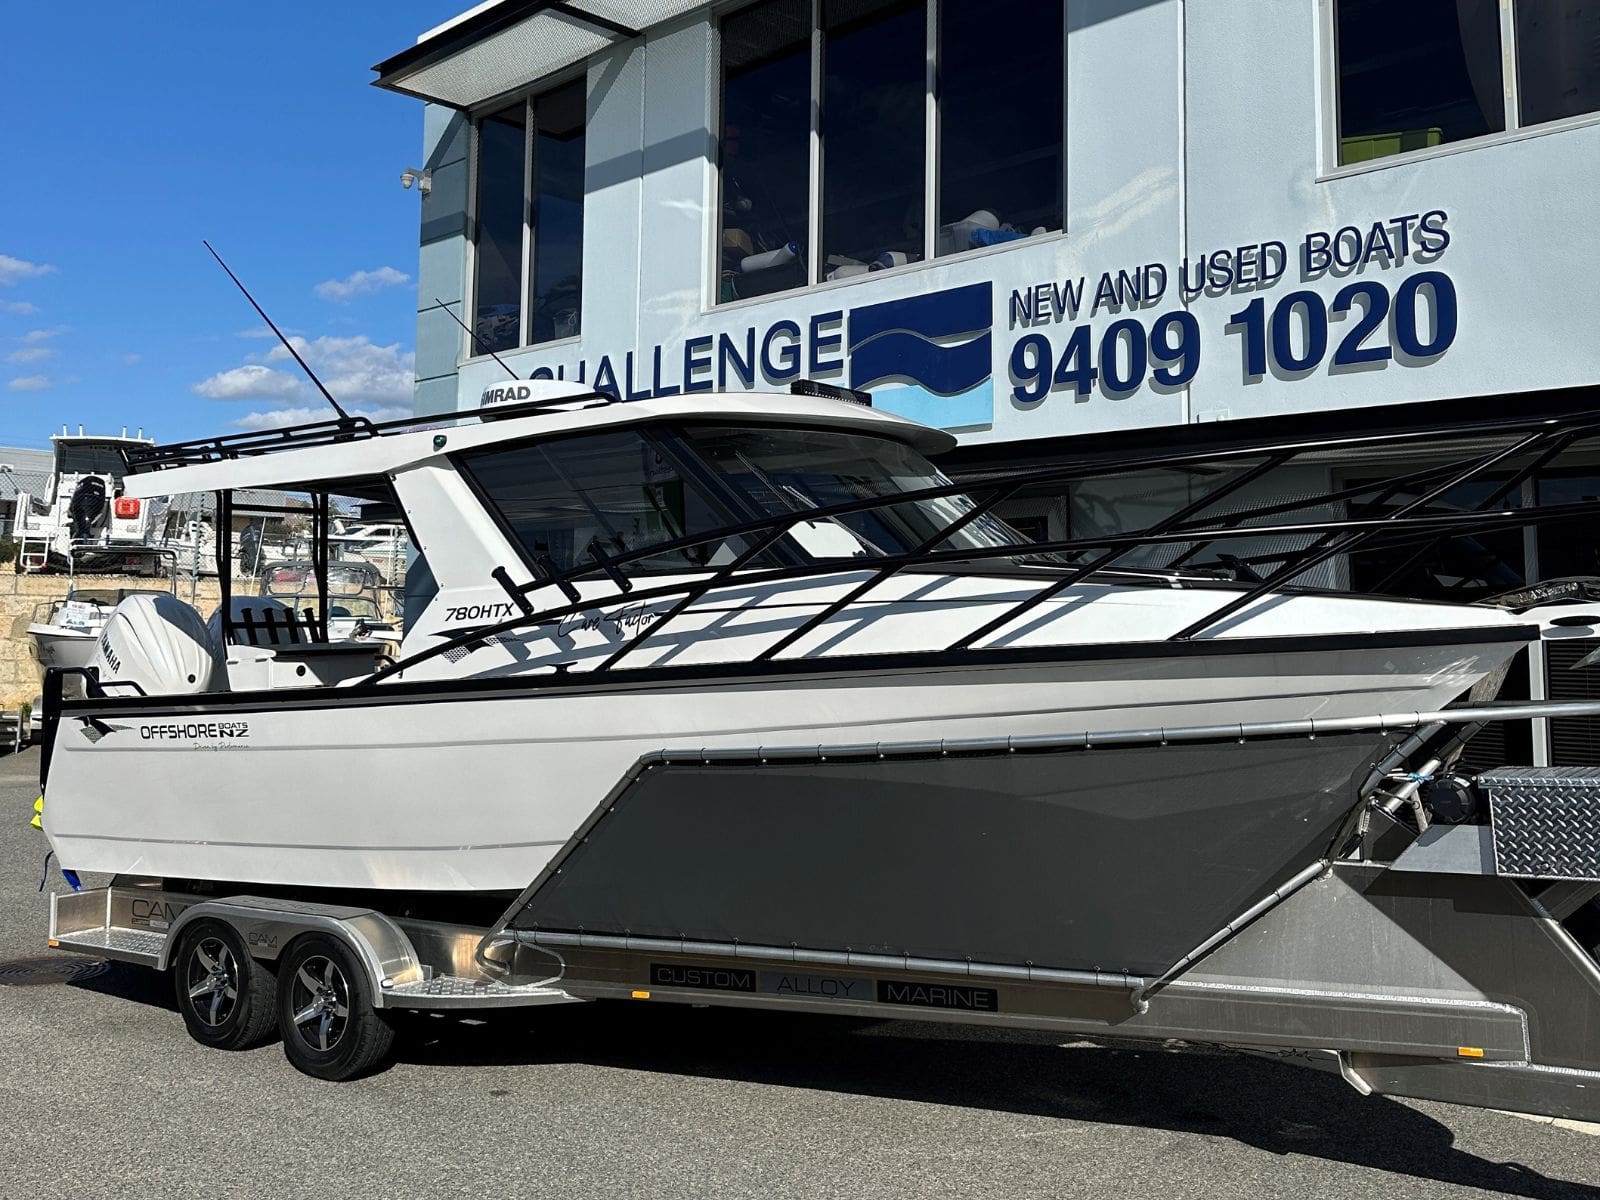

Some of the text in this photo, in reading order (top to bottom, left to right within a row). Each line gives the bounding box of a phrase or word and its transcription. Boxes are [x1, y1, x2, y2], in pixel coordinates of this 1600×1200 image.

[1012, 210, 1451, 322] NEW AND USED BOATS
[529, 310, 844, 402] HALLENGE
[1012, 271, 1458, 403] 9409 1020
[444, 602, 514, 622] 780HTX
[140, 722, 249, 739] OFFSHORE BOATS
[219, 729, 249, 738] NZ
[656, 967, 990, 1008] CUSTOM ALLOY MARINE
